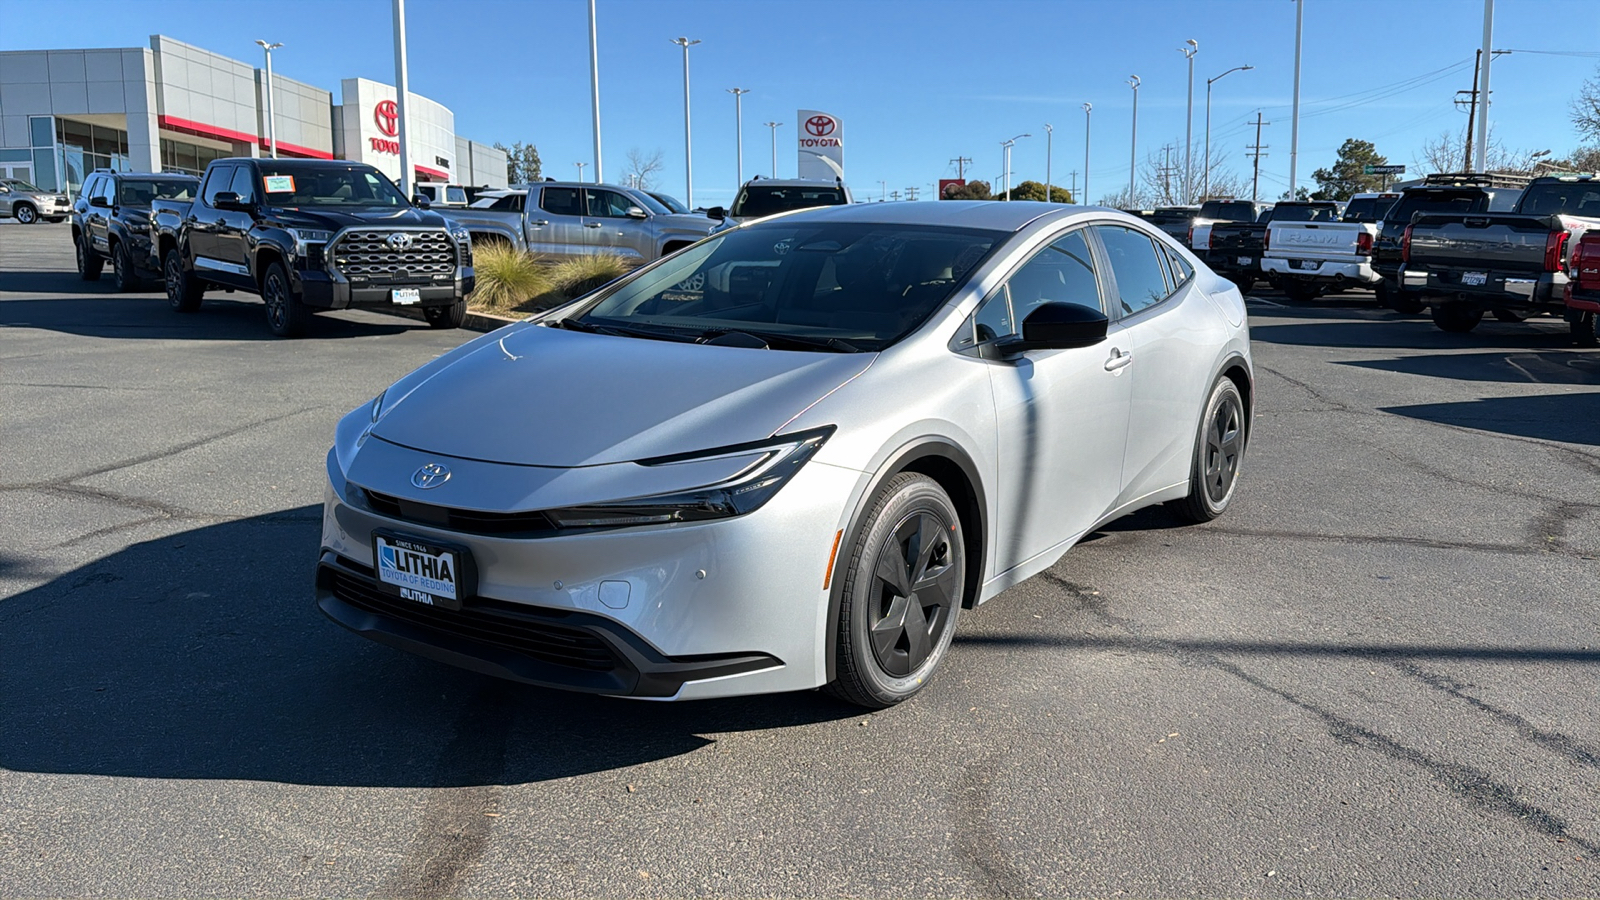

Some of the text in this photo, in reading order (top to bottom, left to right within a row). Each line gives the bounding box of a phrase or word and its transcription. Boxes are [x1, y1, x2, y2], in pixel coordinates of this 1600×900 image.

[370, 137, 400, 155] TOYO
[800, 138, 842, 147] TOYOTA
[1286, 233, 1339, 245] RAM
[395, 540, 427, 553] SINCE 1946
[395, 549, 454, 583] LITHIA
[381, 568, 455, 593] TOYOTA OF REDDING
[407, 589, 434, 606] LITHIA
